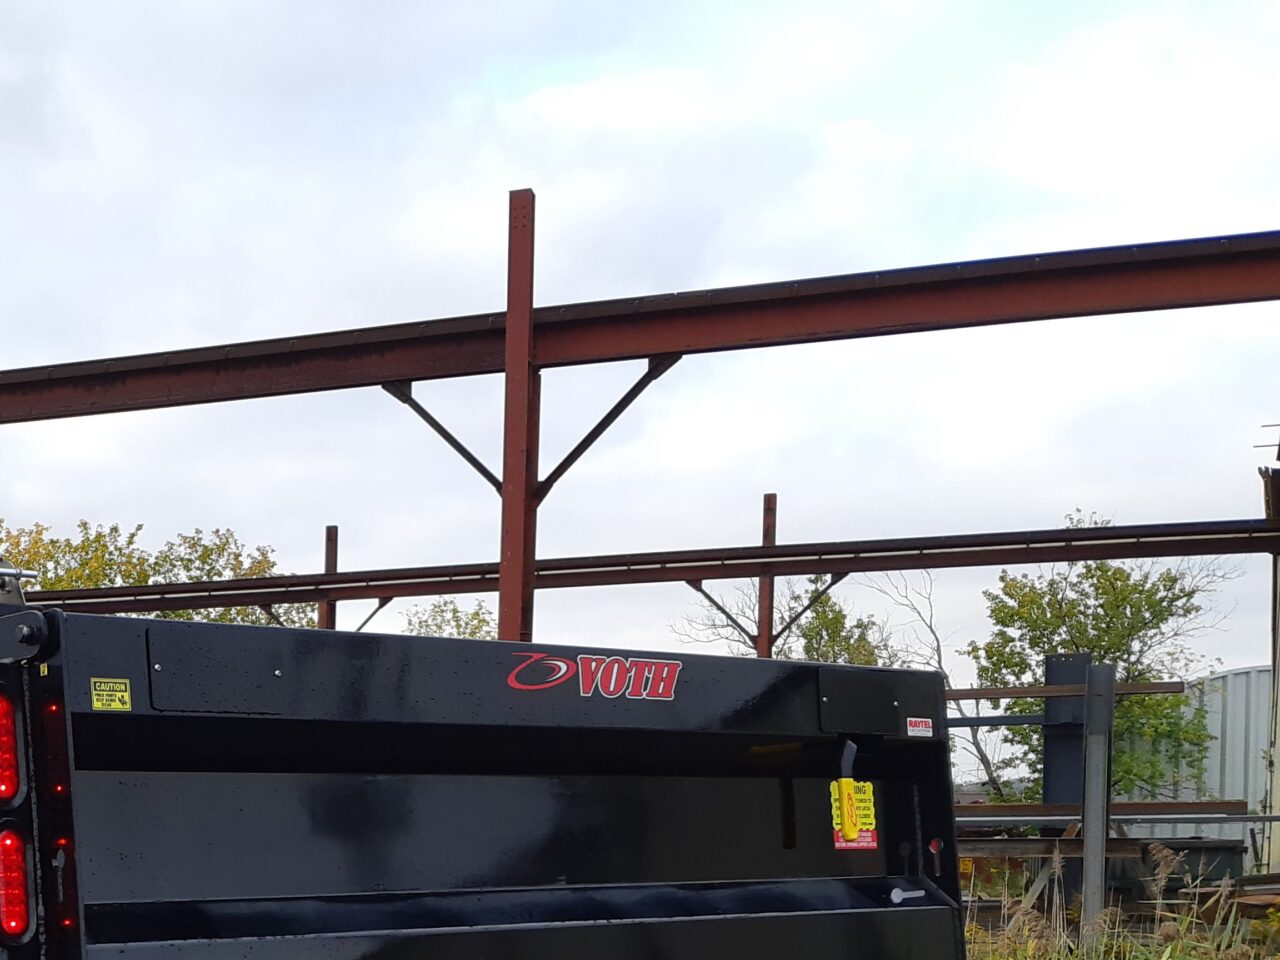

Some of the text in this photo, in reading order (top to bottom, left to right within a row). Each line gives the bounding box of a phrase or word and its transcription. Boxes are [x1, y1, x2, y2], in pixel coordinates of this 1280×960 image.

[577, 654, 682, 700] VOTH
[95, 682, 125, 692] CAUTION
[909, 720, 932, 728] RAYTEL
